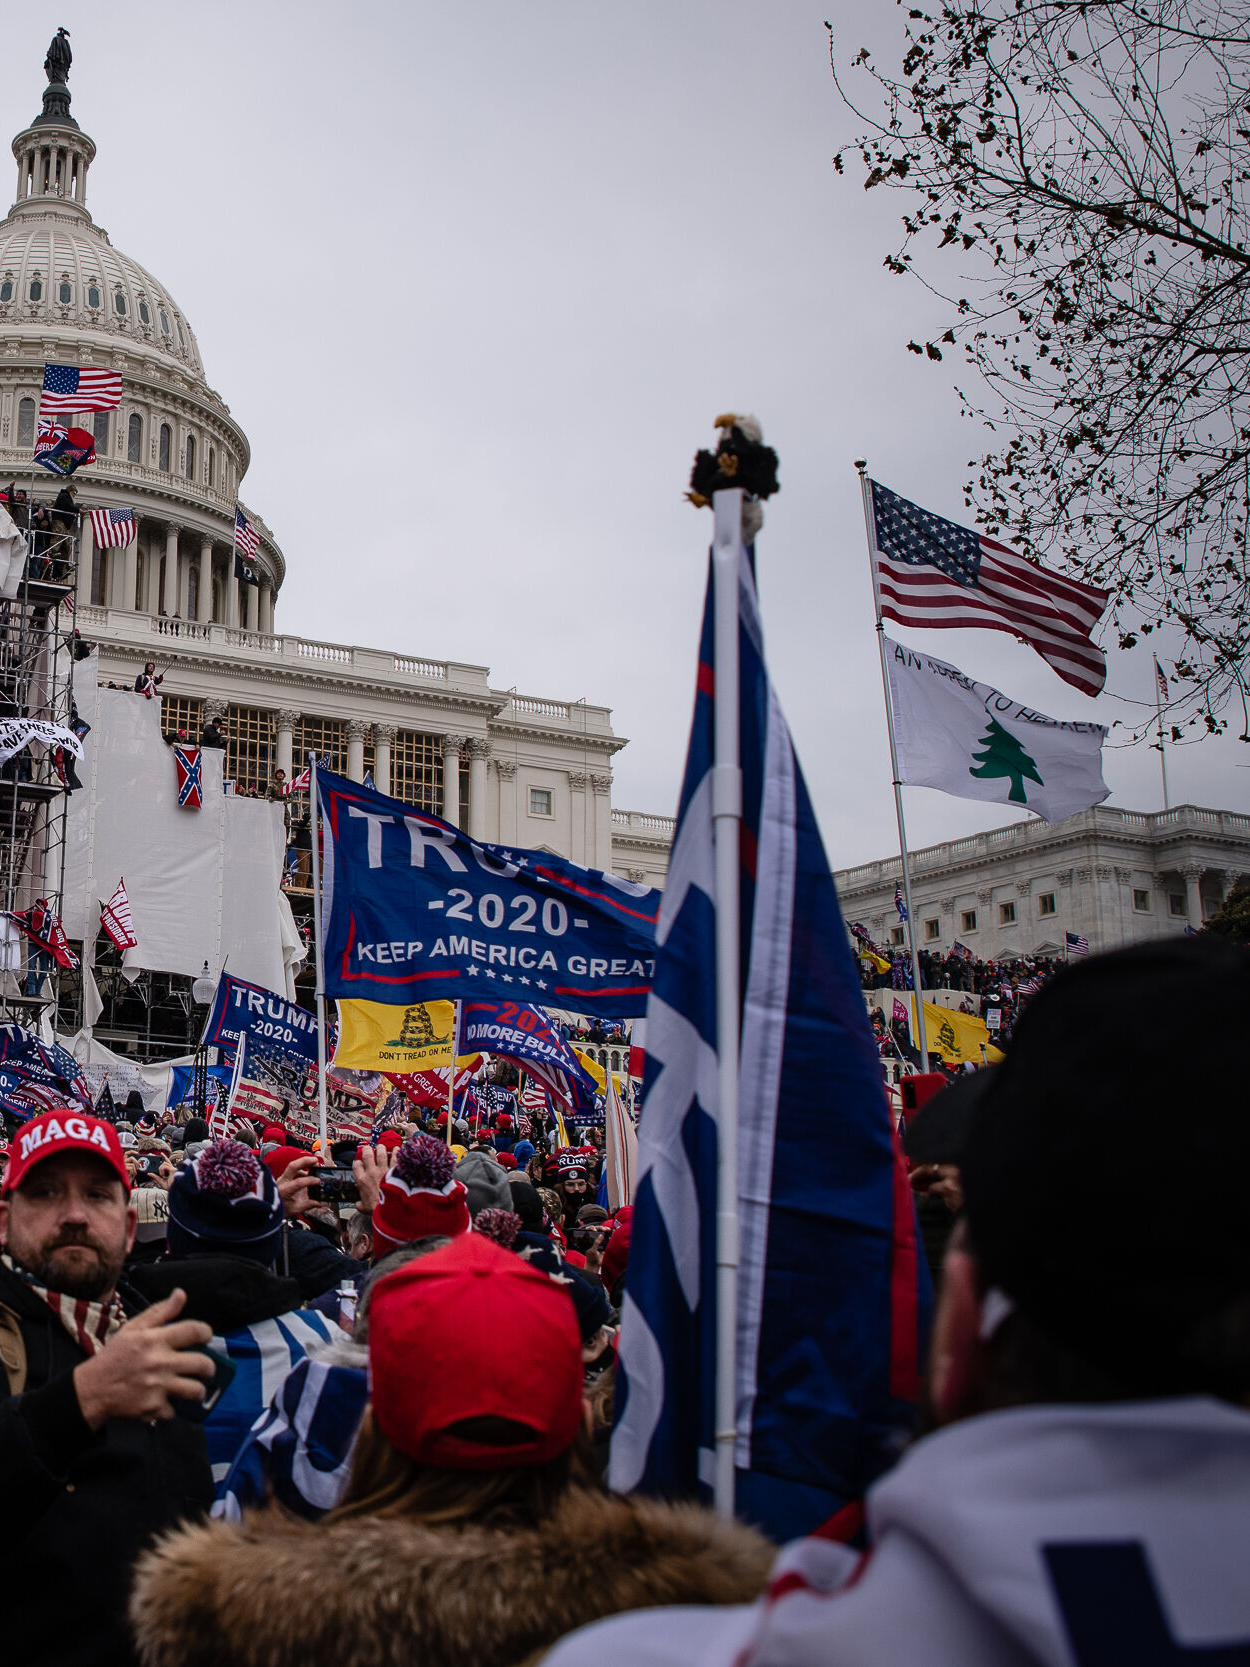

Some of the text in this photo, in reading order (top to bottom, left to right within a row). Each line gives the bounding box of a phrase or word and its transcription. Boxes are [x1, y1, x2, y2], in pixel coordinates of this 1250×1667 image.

[894, 644, 922, 671] AN
[984, 688, 1013, 712] TO
[348, 805, 520, 878] TRU
[428, 888, 588, 936] -2020-
[102, 911, 129, 946] PRESIDENT
[357, 941, 423, 964] KEEP
[429, 935, 558, 971] AMERICA
[221, 1028, 240, 1041] KEE
[250, 1020, 298, 1043] -2020-
[476, 1023, 526, 1045] MORE
[378, 1050, 402, 1061] DON'T
[403, 1051, 427, 1061] TREAD
[428, 1047, 439, 1055] ON
[413, 1073, 438, 1096] GREAT
[20, 1118, 111, 1160] MAGA
[295, 1123, 317, 1140] Bear
